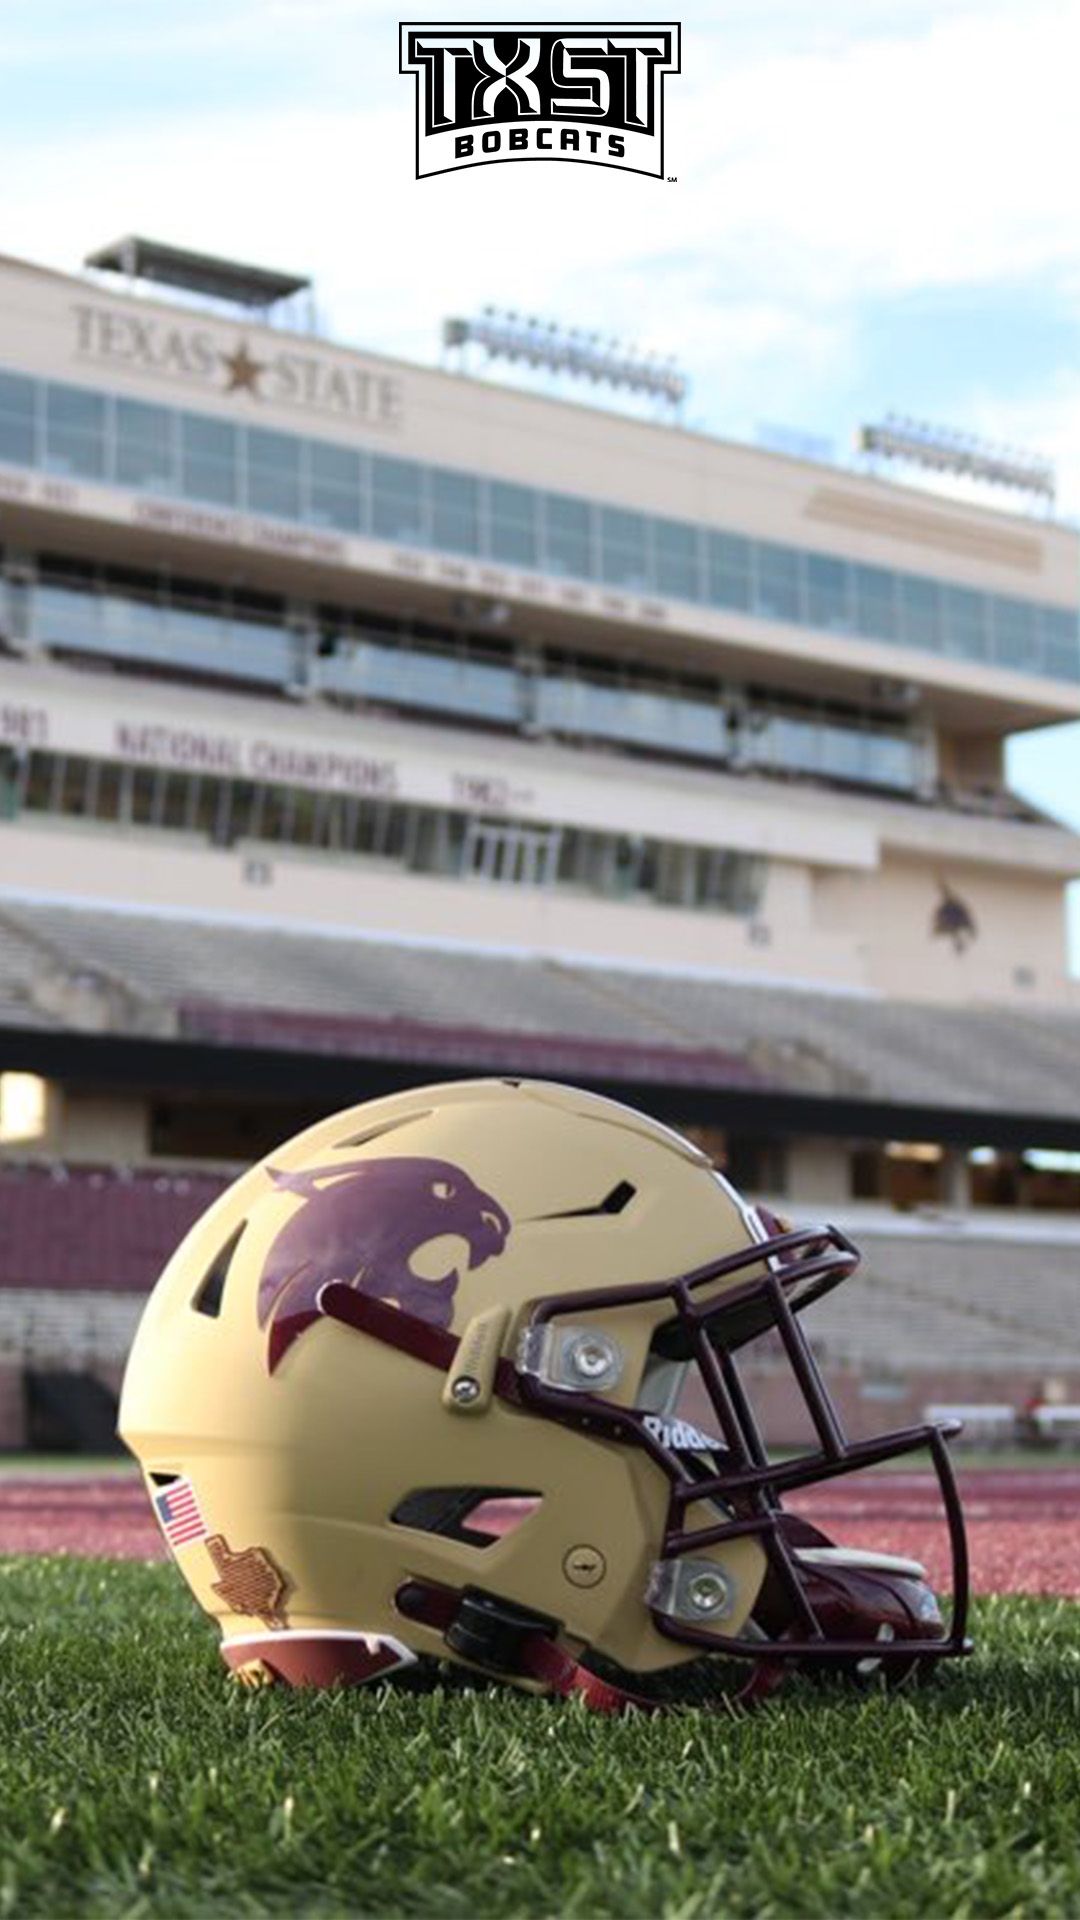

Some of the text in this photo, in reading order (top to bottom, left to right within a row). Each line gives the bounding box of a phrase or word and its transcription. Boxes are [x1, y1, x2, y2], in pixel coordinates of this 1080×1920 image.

[70, 304, 404, 427] TEXAS STATE
[115, 722, 398, 793] NATIONAL CHAMPIONS
